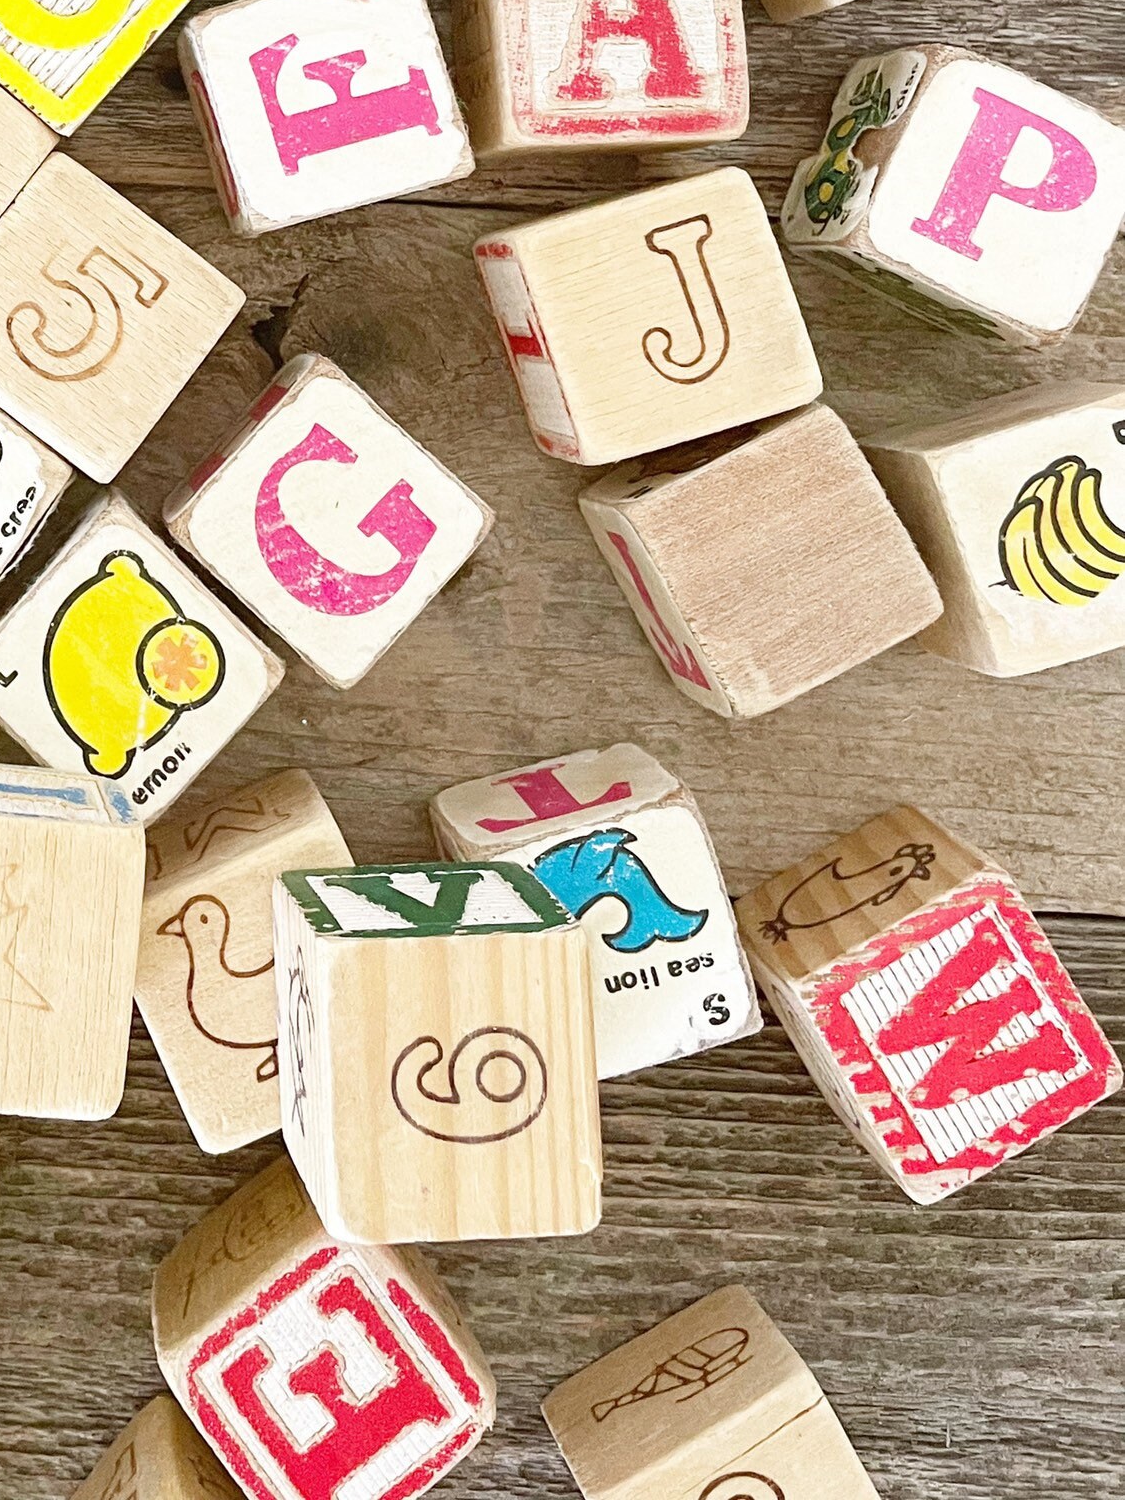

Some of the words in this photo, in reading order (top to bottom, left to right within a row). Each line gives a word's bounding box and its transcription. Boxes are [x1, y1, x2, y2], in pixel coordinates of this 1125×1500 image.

[248, 32, 444, 178] F
[909, 86, 1099, 263] P
[5, 245, 170, 383] 5
[640, 212, 731, 386] J
[1, 482, 38, 538] crea
[254, 422, 438, 616] G
[131, 743, 193, 806] emon
[603, 966, 660, 996] lion
[668, 950, 716, 978] sea
[701, 992, 732, 1027] S
[220, 1276, 453, 1500] E
